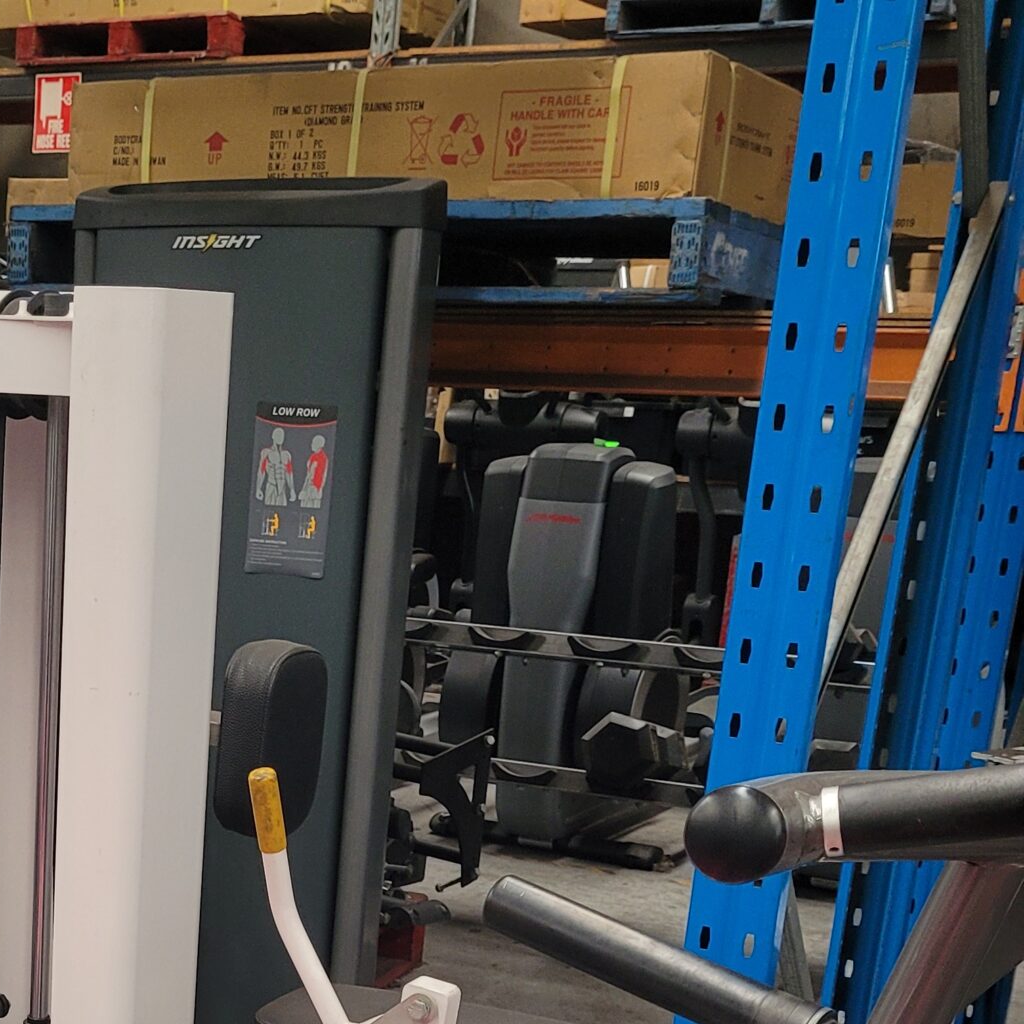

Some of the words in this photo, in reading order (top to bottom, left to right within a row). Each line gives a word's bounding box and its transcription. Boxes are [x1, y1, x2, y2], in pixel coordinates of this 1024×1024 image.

[394, 100, 424, 111] SYSTEM
[539, 94, 592, 107] FRAGILE
[510, 109, 555, 121] HANDLE
[557, 108, 585, 119] WITH
[587, 107, 610, 118] CAR
[56, 133, 71, 149] REE
[113, 135, 142, 144] BODYCRA
[112, 157, 129, 166] MADE
[207, 154, 222, 165] UP
[634, 180, 660, 191] 16019
[172, 233, 261, 252] INSIGHT
[272, 406, 295, 417] LOW
[296, 407, 321, 418] ROW
